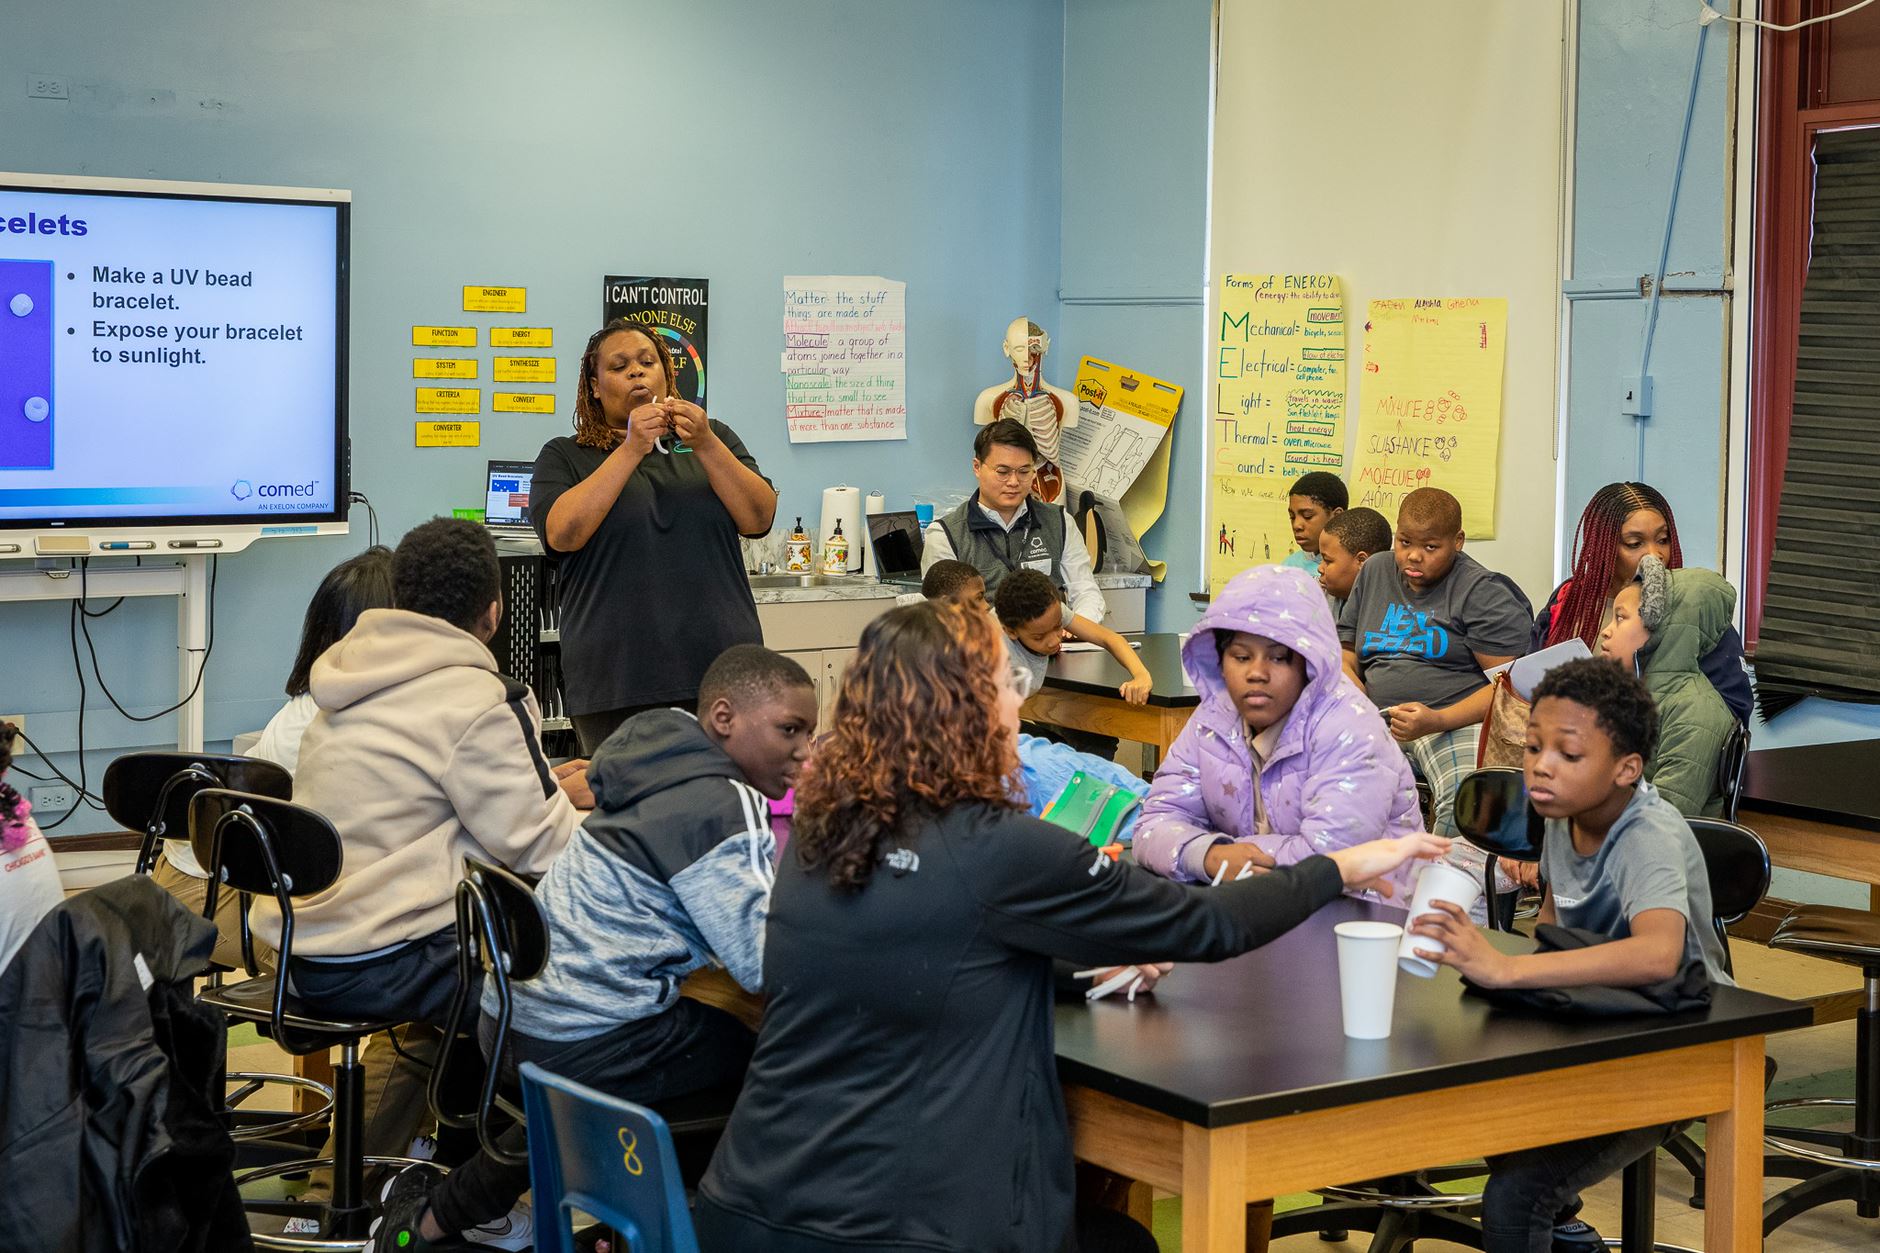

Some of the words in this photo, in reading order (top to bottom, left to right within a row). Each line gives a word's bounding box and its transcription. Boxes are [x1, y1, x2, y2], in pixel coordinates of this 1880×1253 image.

[93, 266, 146, 284] Make
[152, 272, 163, 284] a
[170, 268, 199, 285] UV
[205, 270, 252, 287] bead
[1226, 275, 1253, 288] Forms
[1262, 275, 1275, 288] of
[1284, 275, 1333, 289] ENERGY
[93, 291, 180, 310] bracelet.
[483, 289, 507, 297] ENGINEER
[606, 286, 609, 302] I
[612, 286, 649, 303] CAN'T
[651, 287, 707, 305] CONTROL
[837, 291, 853, 304] the
[860, 291, 888, 304] stuff
[787, 307, 811, 321] things
[818, 309, 832, 318] are
[836, 306, 859, 318] made
[863, 305, 876, 318] of
[624, 310, 668, 324] NYONE
[670, 312, 697, 335] ELSE
[93, 321, 168, 342] Expose
[174, 325, 220, 342] your
[226, 323, 303, 341] bracelet
[838, 337, 845, 346] a
[849, 336, 875, 350] group
[879, 333, 890, 346] of
[93, 346, 112, 363] to
[119, 347, 206, 367] sunlight.
[787, 349, 817, 361] atoms
[819, 349, 846, 363] joined
[850, 349, 884, 363] together
[887, 349, 896, 359] in
[897, 351, 904, 360] a
[787, 364, 828, 377] particular
[832, 367, 850, 376] way
[835, 376, 848, 388] the
[787, 391, 807, 403] that
[810, 395, 824, 403] are
[826, 393, 834, 402] to
[838, 390, 859, 402] small
[863, 391, 872, 401] to
[874, 393, 887, 401] see
[1081, 384, 1104, 400] Post-it
[827, 405, 855, 417] matter
[857, 404, 873, 416] that
[876, 405, 883, 415] is
[886, 404, 906, 415] made
[789, 420, 798, 431] of
[799, 423, 818, 431] more
[821, 419, 839, 431] than
[840, 421, 853, 430] one
[857, 418, 895, 429] substance
[258, 481, 315, 498] comed
[618, 1127, 643, 1175] 8
